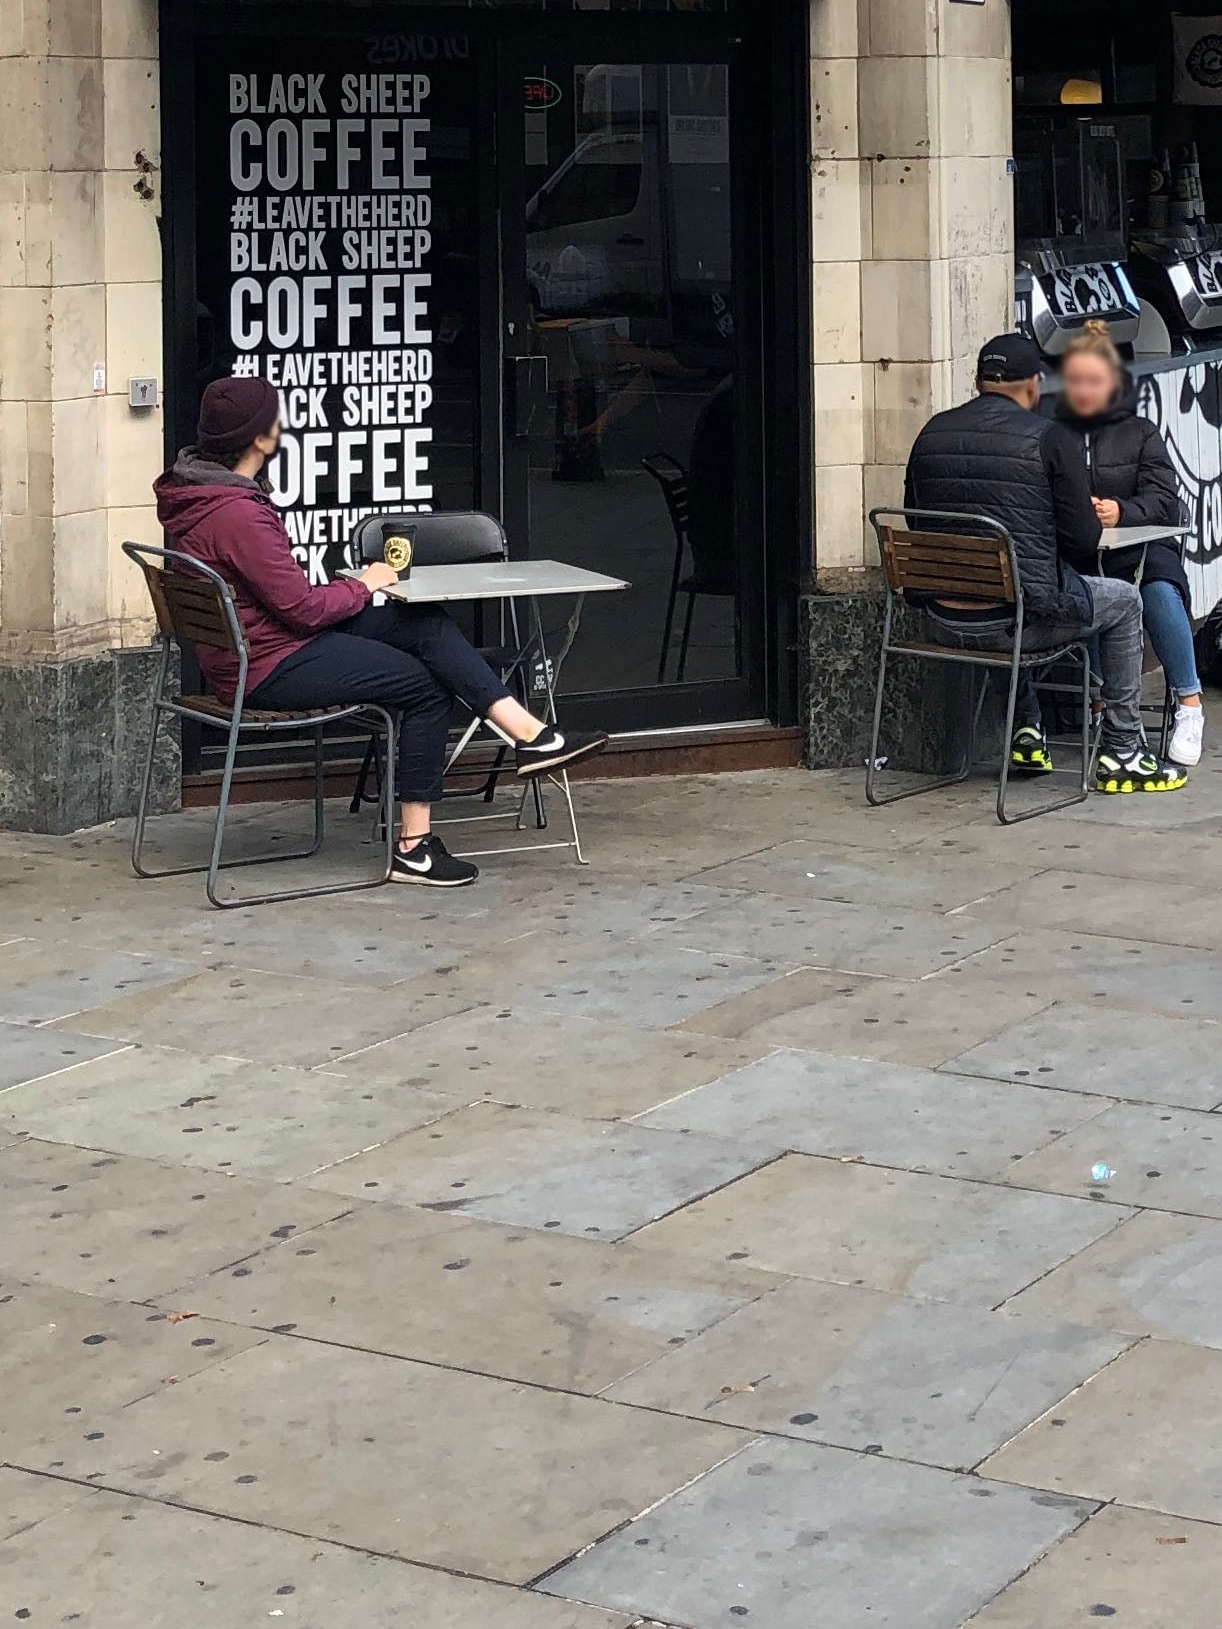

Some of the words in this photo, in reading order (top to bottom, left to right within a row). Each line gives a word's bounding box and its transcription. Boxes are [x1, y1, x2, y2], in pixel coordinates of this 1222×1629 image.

[229, 74, 326, 114] BLACK
[342, 74, 430, 113] SHEEP
[229, 119, 431, 191] COFFEE
[230, 195, 431, 230] #LEAVETHEHERD
[229, 231, 327, 272] BLACK
[342, 230, 431, 270] SHEEP
[230, 274, 432, 351] COFFEE
[231, 349, 432, 387] #LEAVETHEHERD
[278, 387, 329, 428] ACK
[342, 384, 433, 427] SHEEP
[268, 428, 433, 508] OFFEE
